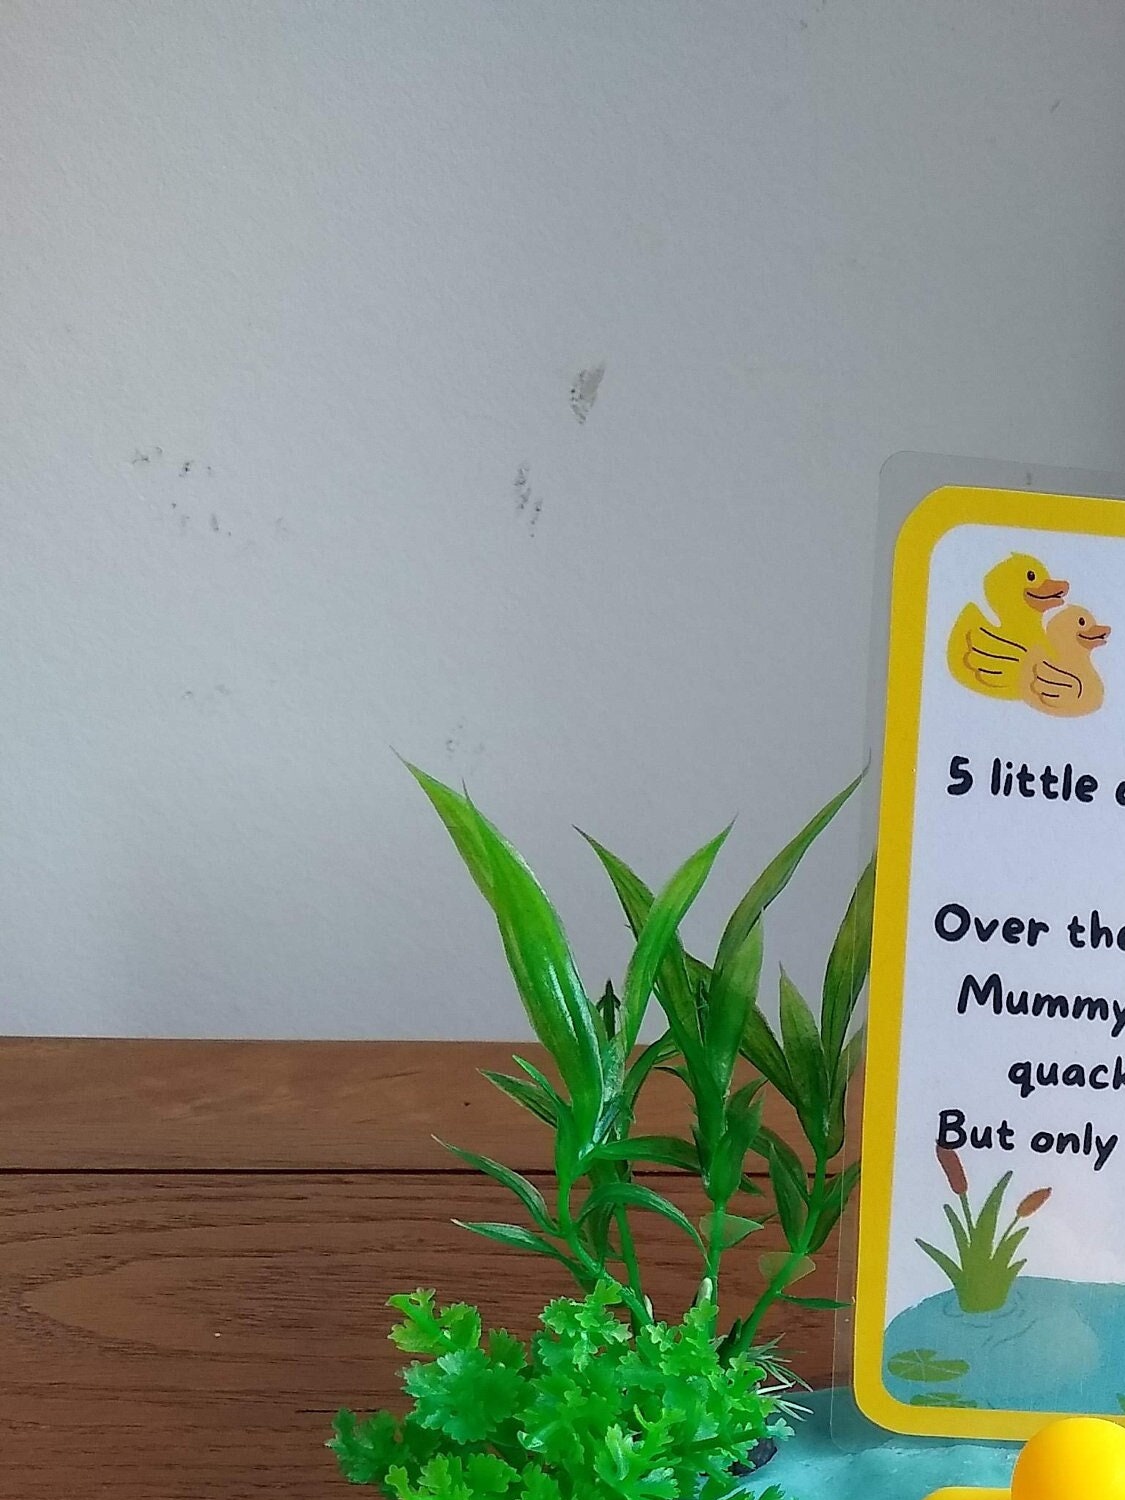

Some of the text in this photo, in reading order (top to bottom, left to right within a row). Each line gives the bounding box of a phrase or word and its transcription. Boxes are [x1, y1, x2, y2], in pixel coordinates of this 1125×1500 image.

[946, 755, 974, 796] 5
[990, 757, 1099, 803] little
[934, 903, 1050, 947] Over
[936, 1109, 1015, 1151] But
[1030, 1121, 1119, 1172] only
